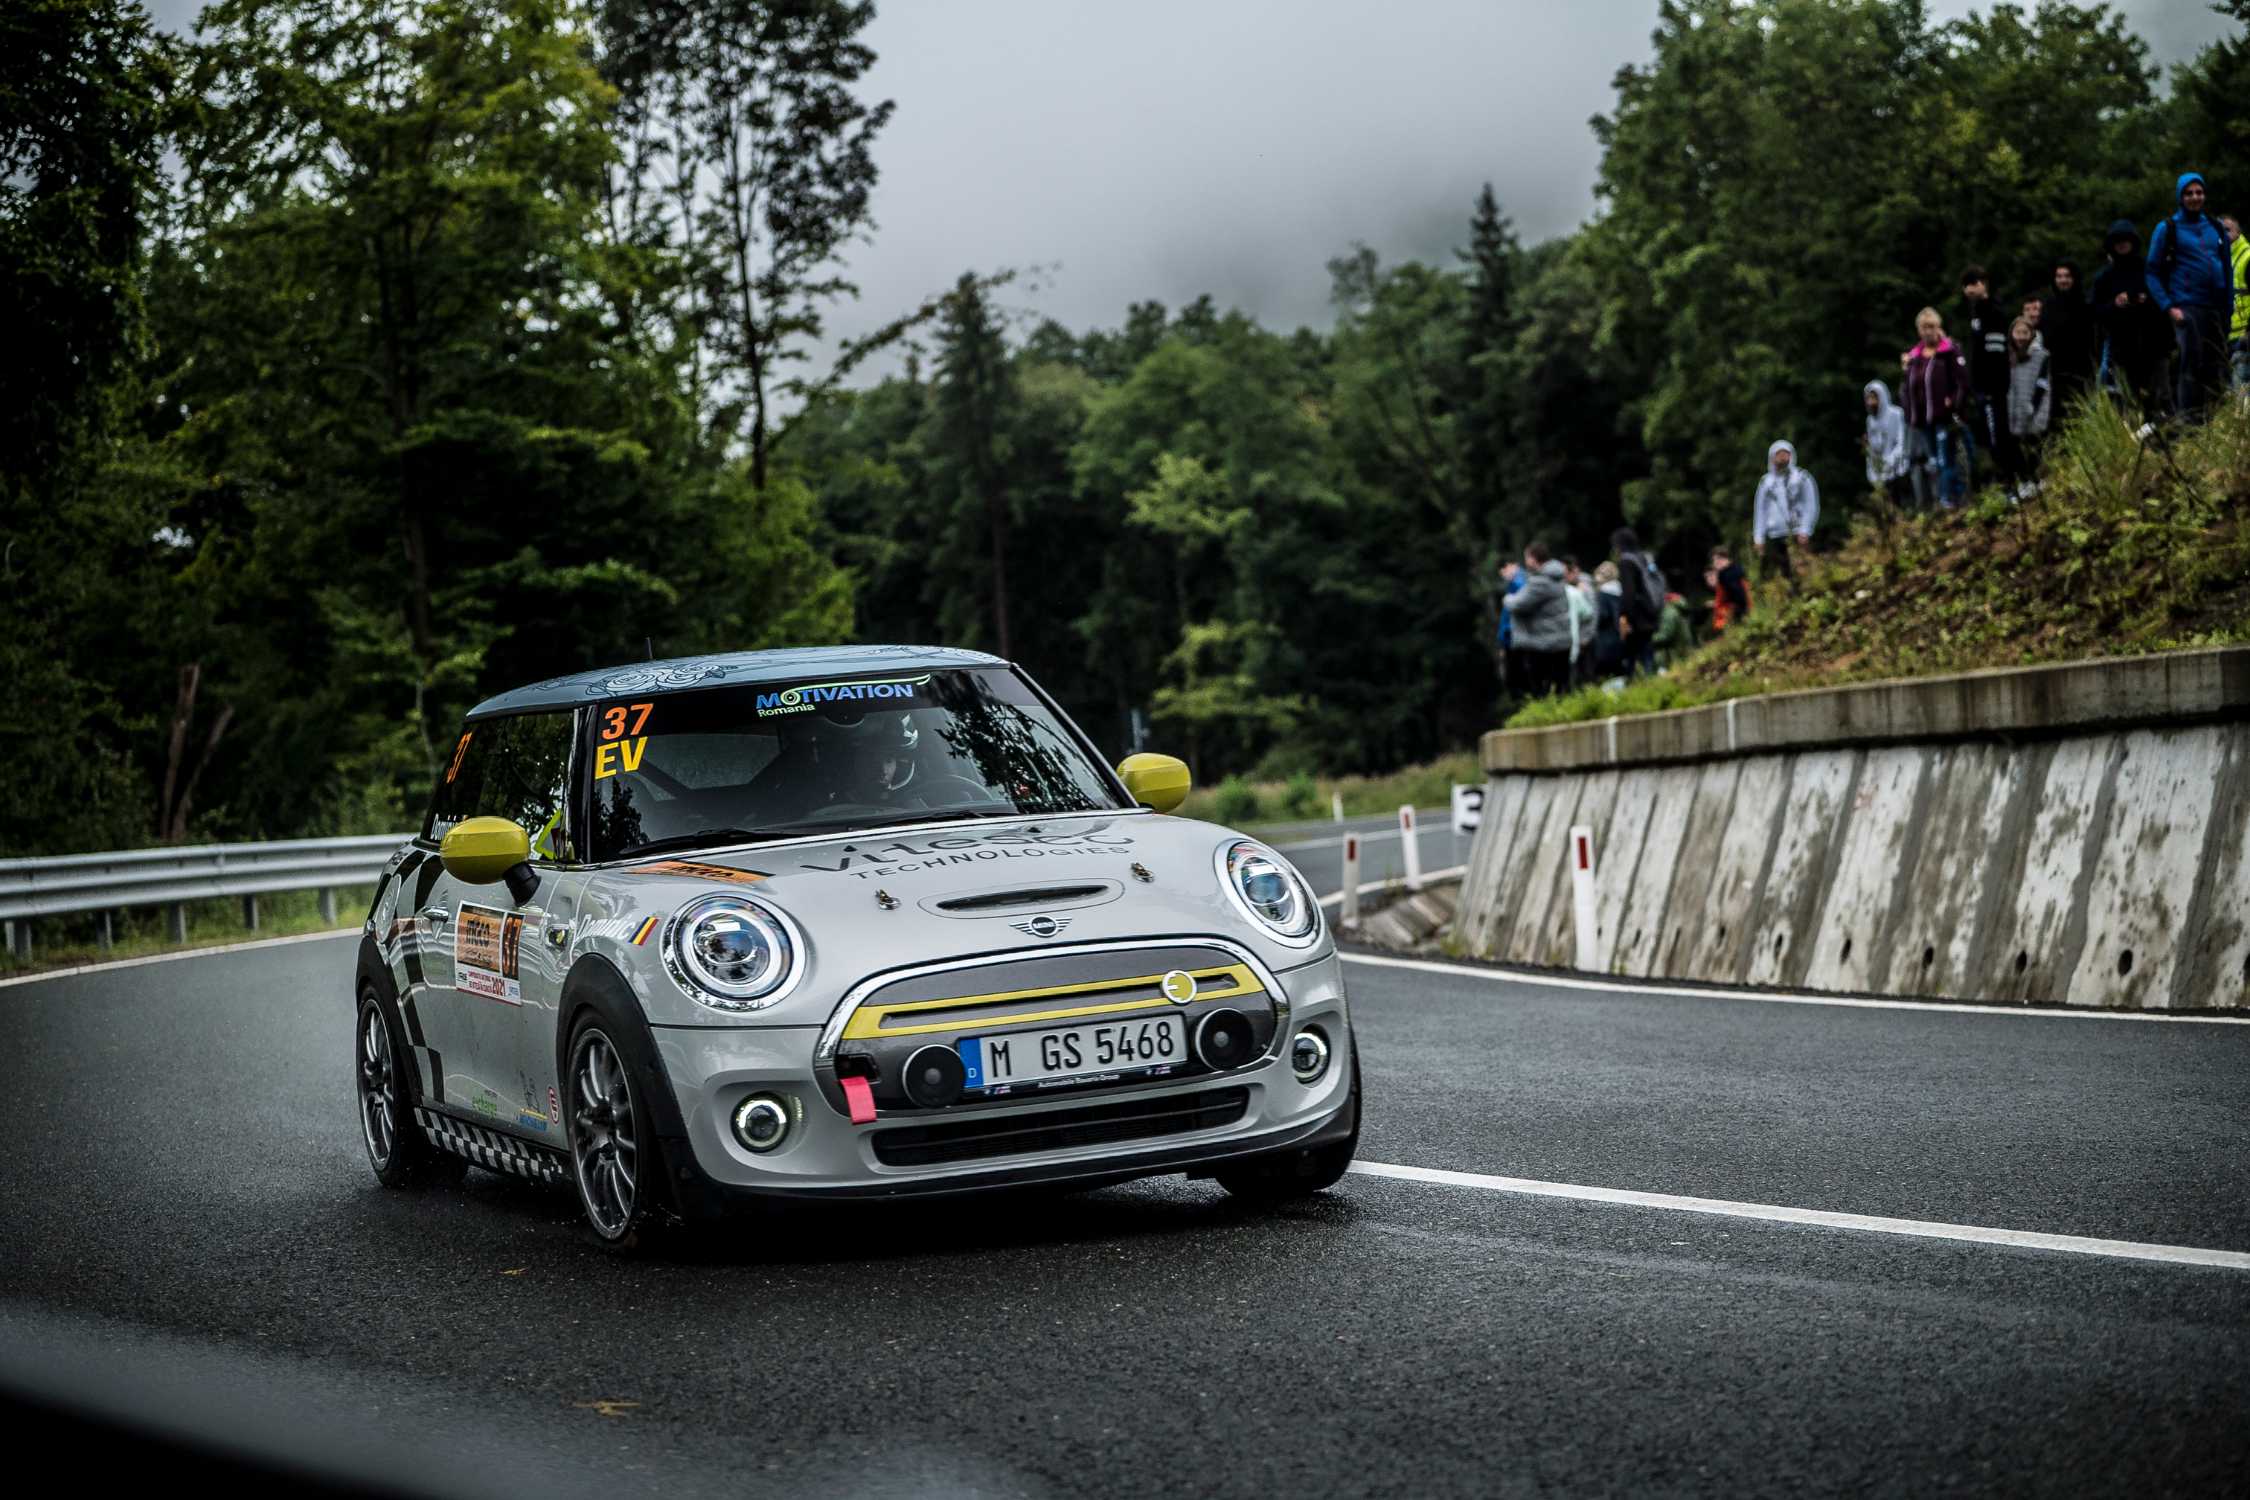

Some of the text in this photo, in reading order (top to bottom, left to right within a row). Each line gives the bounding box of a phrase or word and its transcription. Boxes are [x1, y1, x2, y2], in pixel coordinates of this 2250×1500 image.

[755, 683, 913, 709] MOTIVATION
[757, 702, 815, 717] Romania
[602, 703, 654, 740] 37
[595, 736, 648, 780] EV
[848, 846, 1130, 880] TECHNOLOGIES
[967, 1020, 1174, 1078] D M GS 5468
